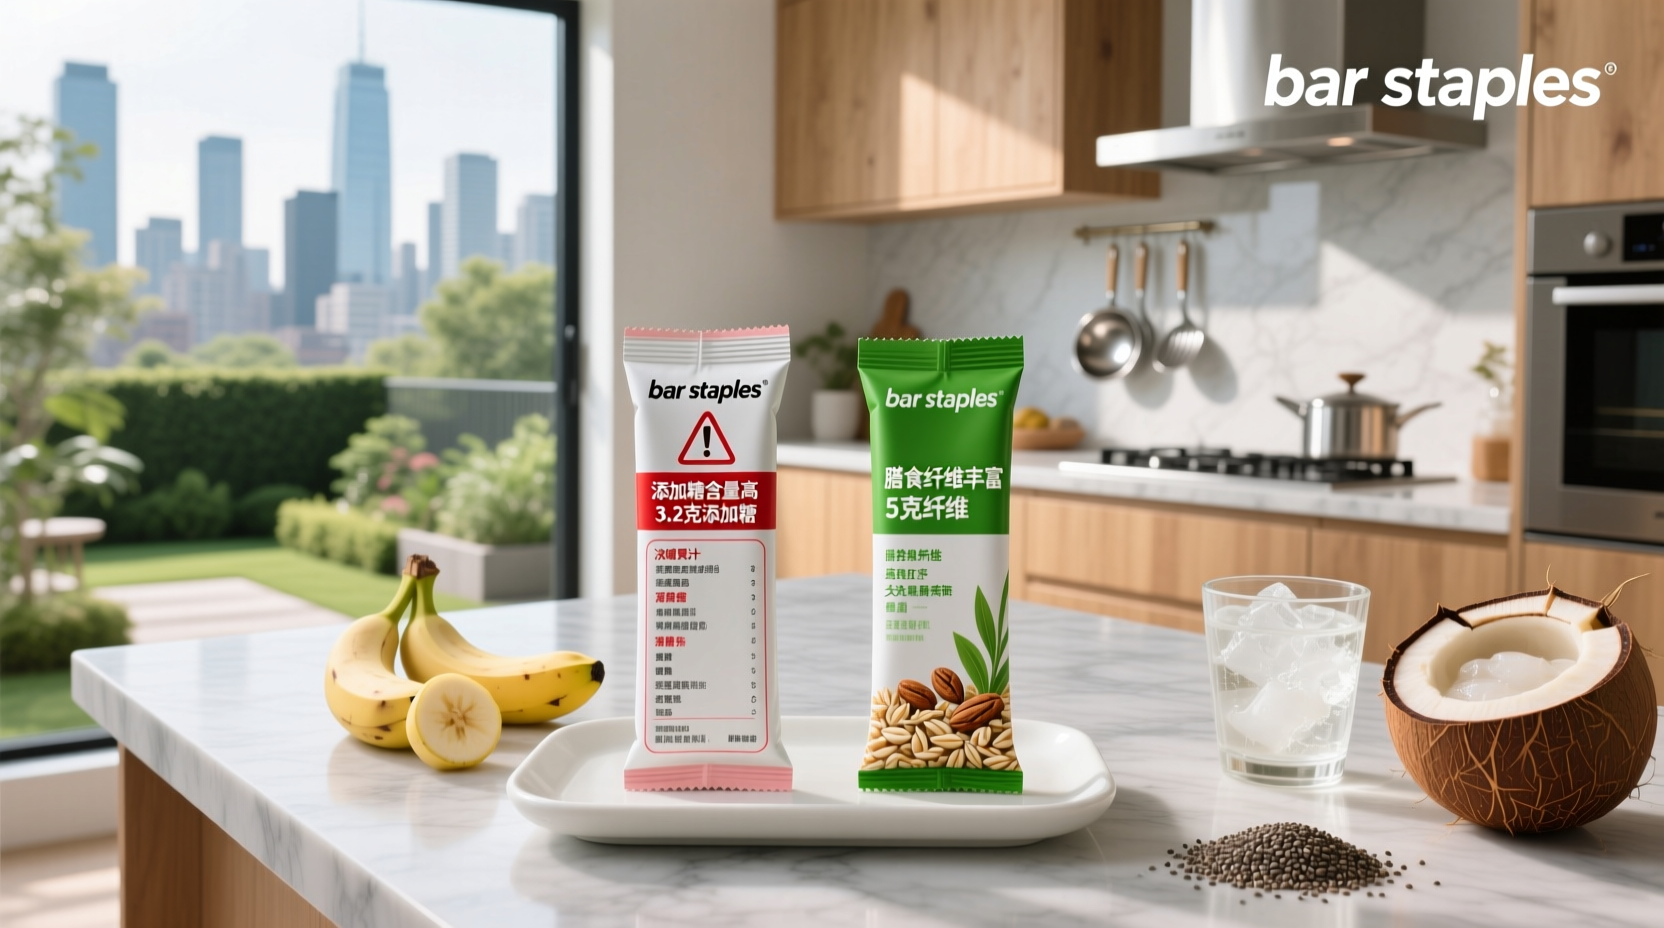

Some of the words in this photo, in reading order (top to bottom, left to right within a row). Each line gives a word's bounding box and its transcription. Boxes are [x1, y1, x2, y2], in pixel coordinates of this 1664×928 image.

[648, 379, 686, 400] bar
[885, 387, 922, 408] bar
[884, 465, 1004, 490] 膳食纤维丰富
[651, 480, 759, 501] 添加糖含量高
[655, 502, 757, 525] 3.2克添加糖
[885, 495, 969, 521] 5克纤维
